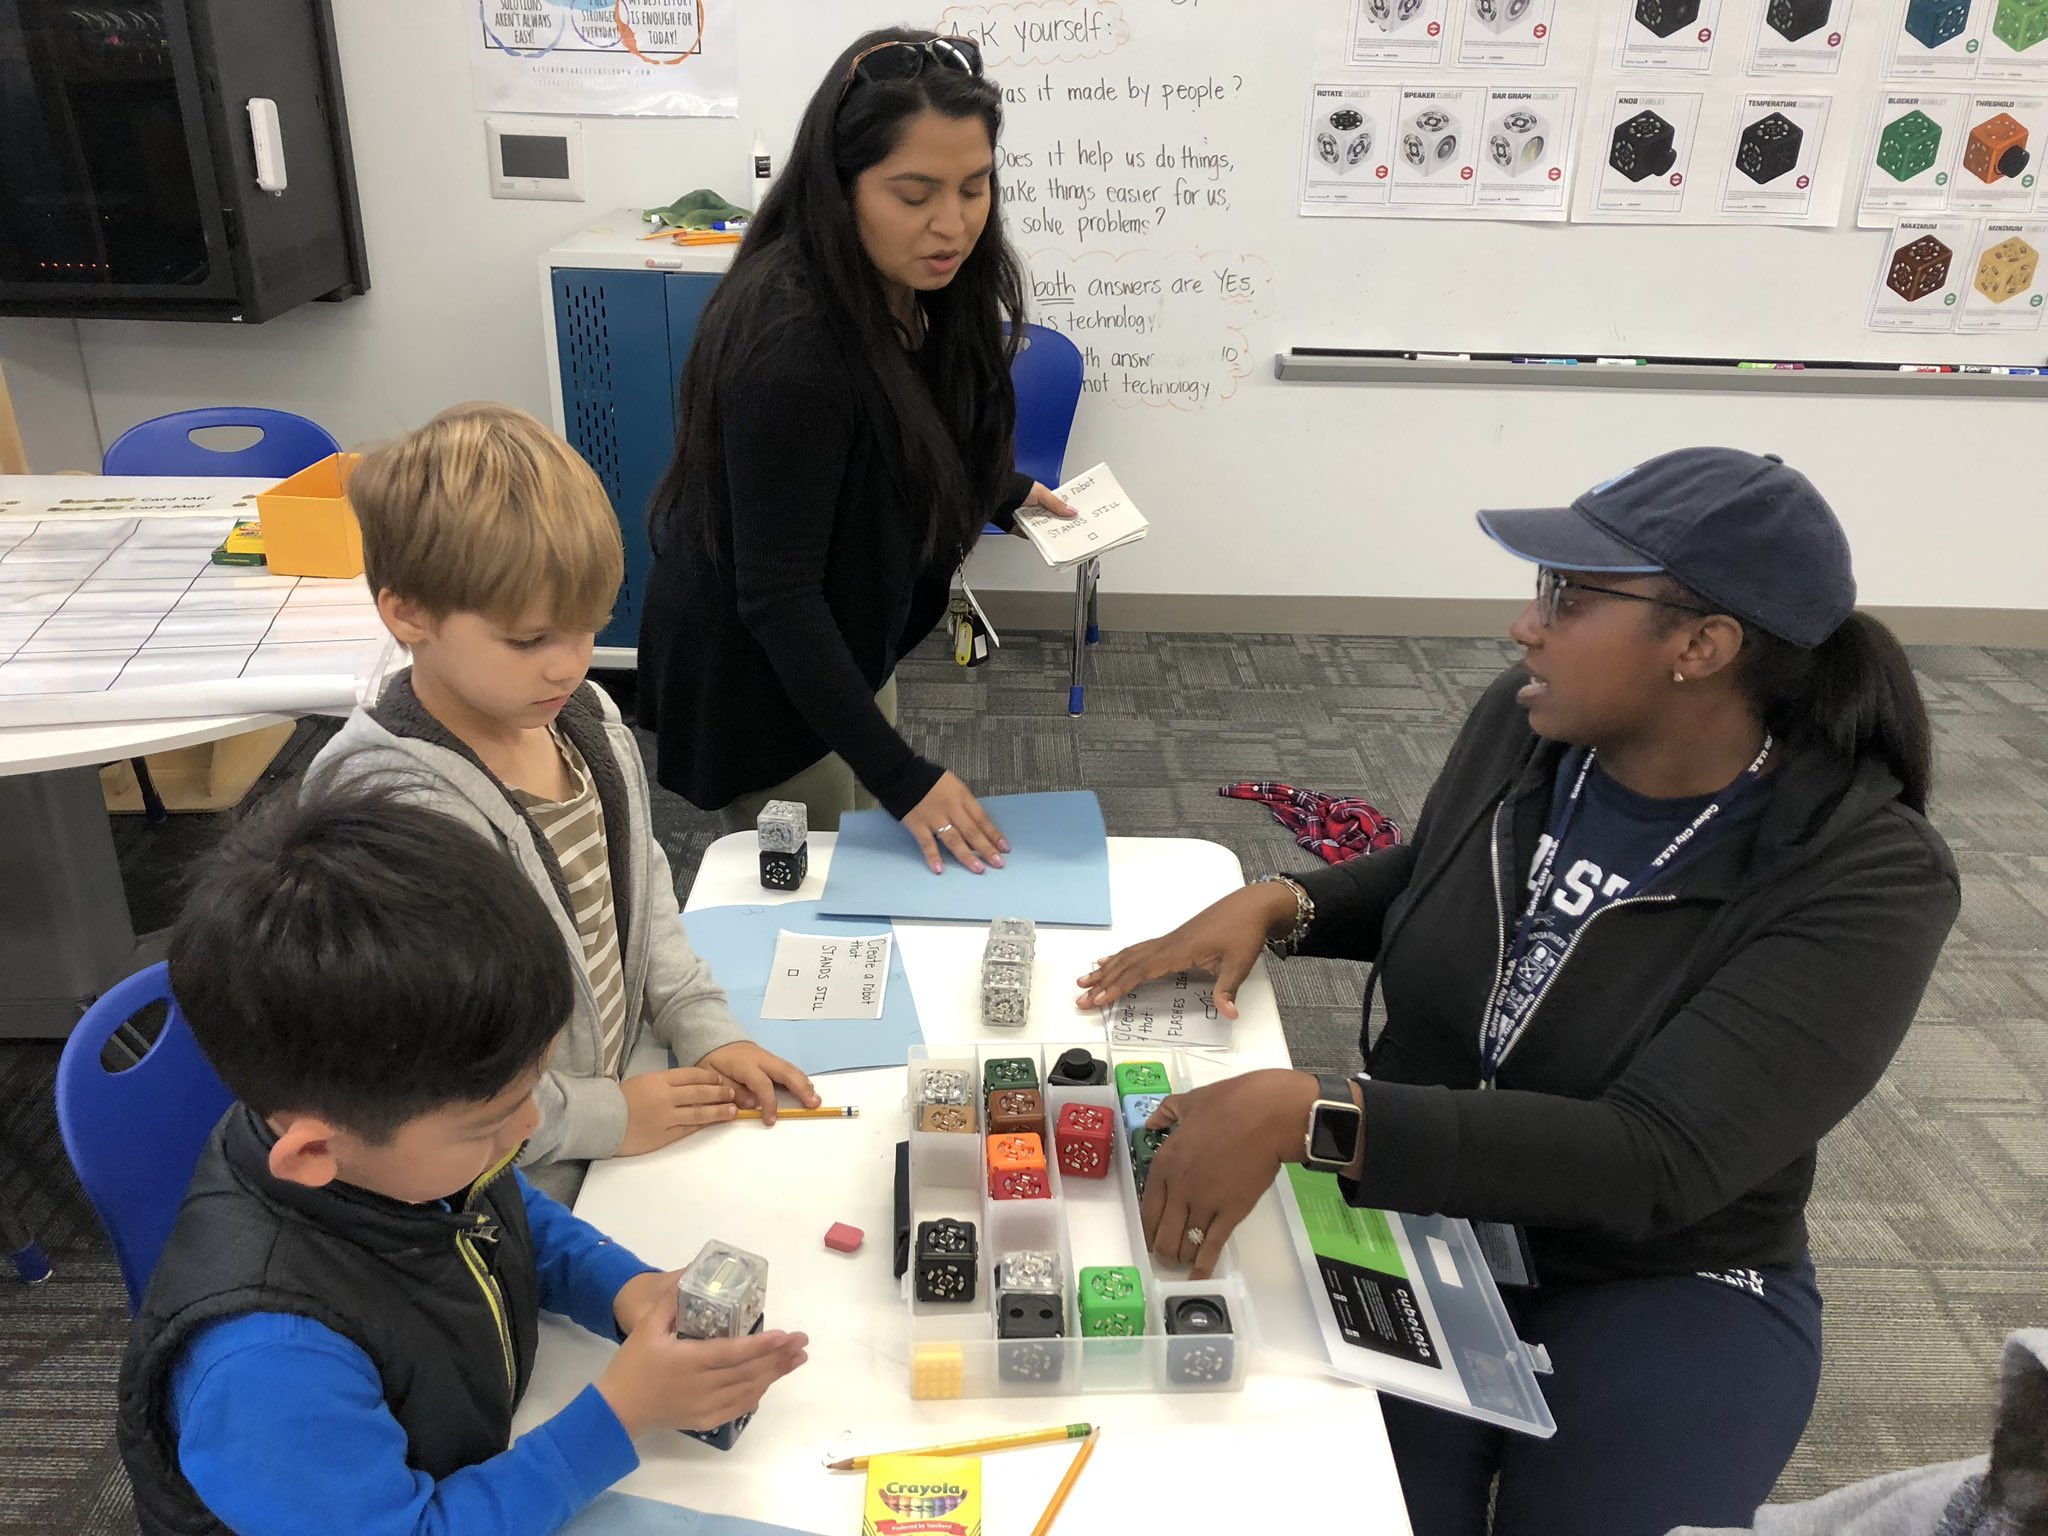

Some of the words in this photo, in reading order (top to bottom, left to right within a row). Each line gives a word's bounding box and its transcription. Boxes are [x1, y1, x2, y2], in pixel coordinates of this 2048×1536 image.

[495, 12, 520, 27] AREN'T
[522, 13, 552, 28] ALWAYS
[630, 11, 640, 25] IS
[642, 11, 675, 26] ENOUGH
[678, 12, 693, 26] FOR
[515, 29, 535, 44] EASY!
[648, 30, 678, 45] TODAY!
[1038, 74, 1054, 101] it
[1067, 77, 1118, 100] made
[1127, 76, 1150, 107] by
[1317, 90, 1343, 98] ROTATE
[1403, 91, 1436, 99] SPEAKER
[1507, 92, 1532, 100] GRAPH
[1748, 99, 1798, 108] TEMPERATURE
[1048, 140, 1065, 167] it
[1077, 138, 1114, 172] help
[1125, 151, 1146, 168] us
[1155, 143, 1176, 168] do
[1048, 177, 1096, 211] things
[1106, 185, 1162, 204] easier
[1174, 176, 1201, 207] for
[1020, 206, 1065, 235] solve
[1901, 222, 1938, 230] MAXIMUM
[1030, 269, 1077, 298] both
[1087, 276, 1162, 297] answers
[1170, 277, 1204, 294] are
[1082, 372, 1110, 394] not
[1070, 476, 1096, 496] robot
[1048, 518, 1088, 539] STANDS
[1092, 501, 1121, 518] STILL
[1695, 803, 1719, 829] Culver
[817, 944, 838, 980] STANDS
[863, 938, 887, 970] Create
[811, 986, 828, 1012] STILL
[861, 983, 877, 1005] robot
[1113, 1003, 1137, 1033] Create
[1167, 997, 1186, 1036] FLASHES
[886, 1482, 960, 1497] Crayola
